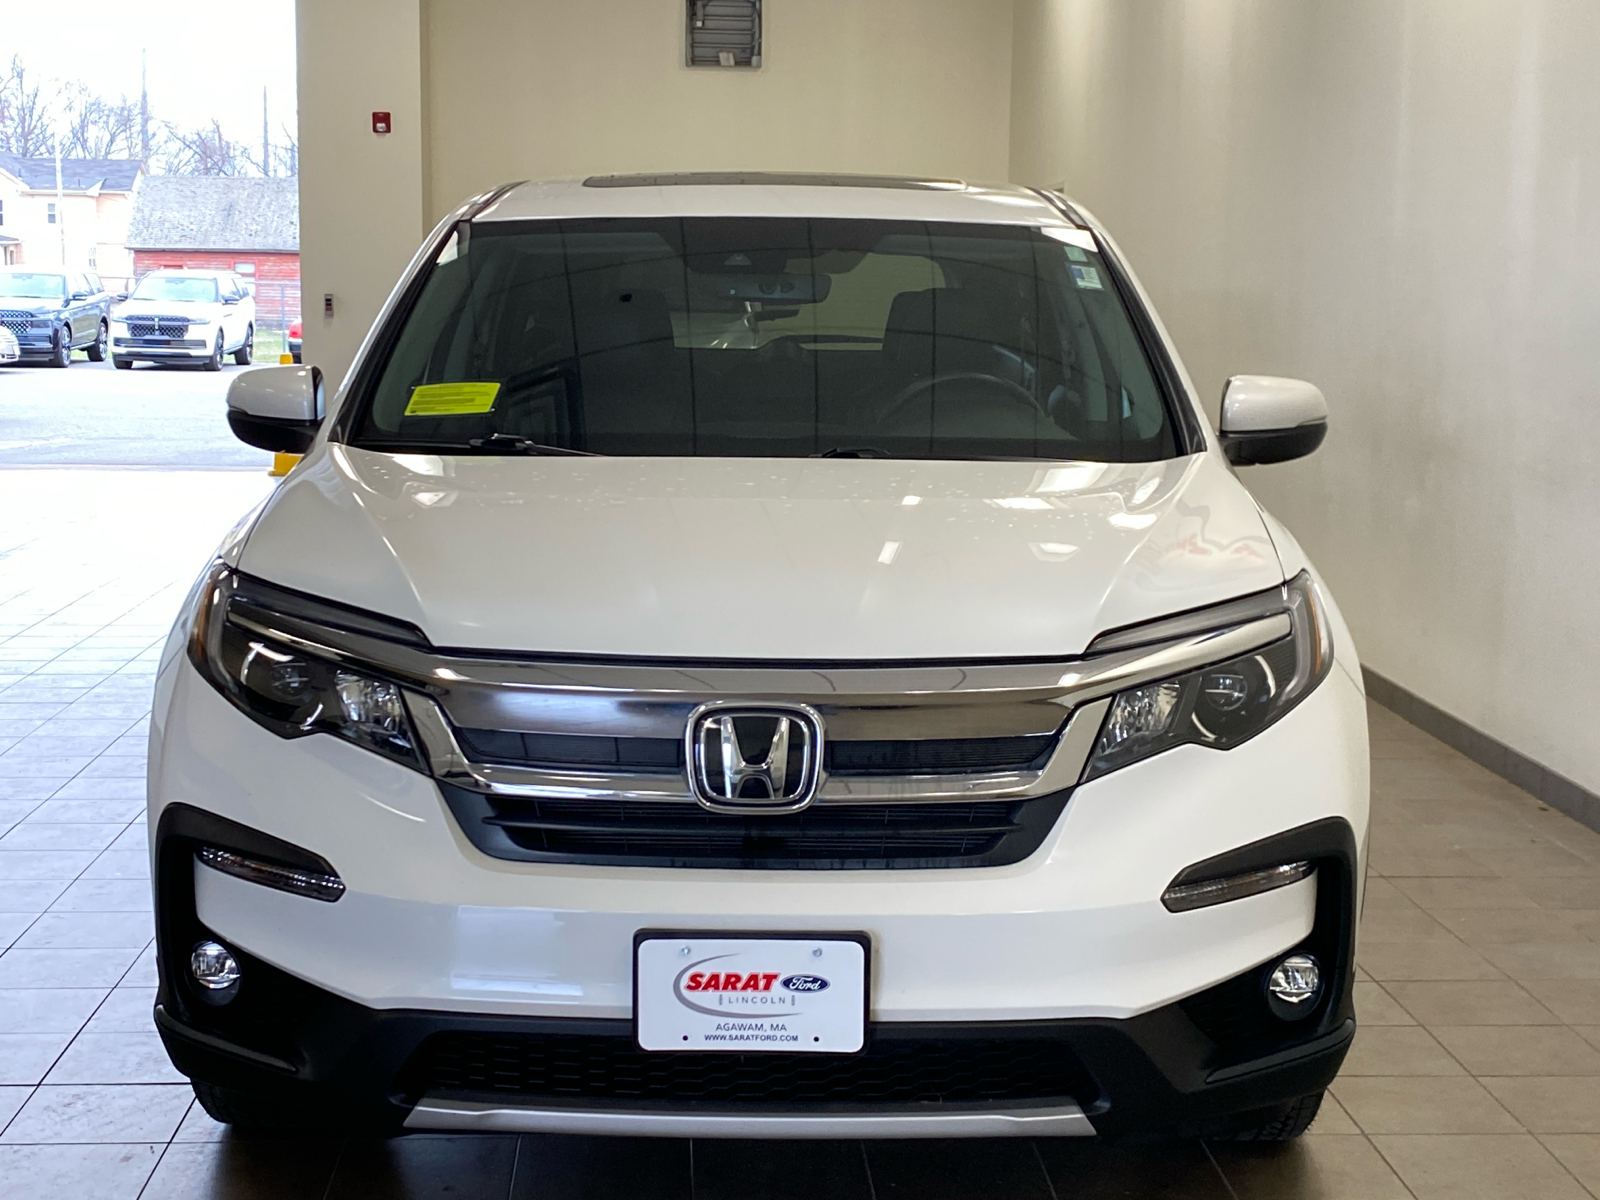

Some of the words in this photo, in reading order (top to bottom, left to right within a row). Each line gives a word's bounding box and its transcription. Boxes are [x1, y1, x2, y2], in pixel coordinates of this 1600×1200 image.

[684, 972, 781, 992] SARAT
[788, 976, 822, 991] Ford
[728, 996, 786, 1005] LINCOLN
[715, 1022, 768, 1033] AGAWAM,
[770, 1022, 788, 1032] MA
[704, 1033, 799, 1042] WWW.SARATFORD.COM
